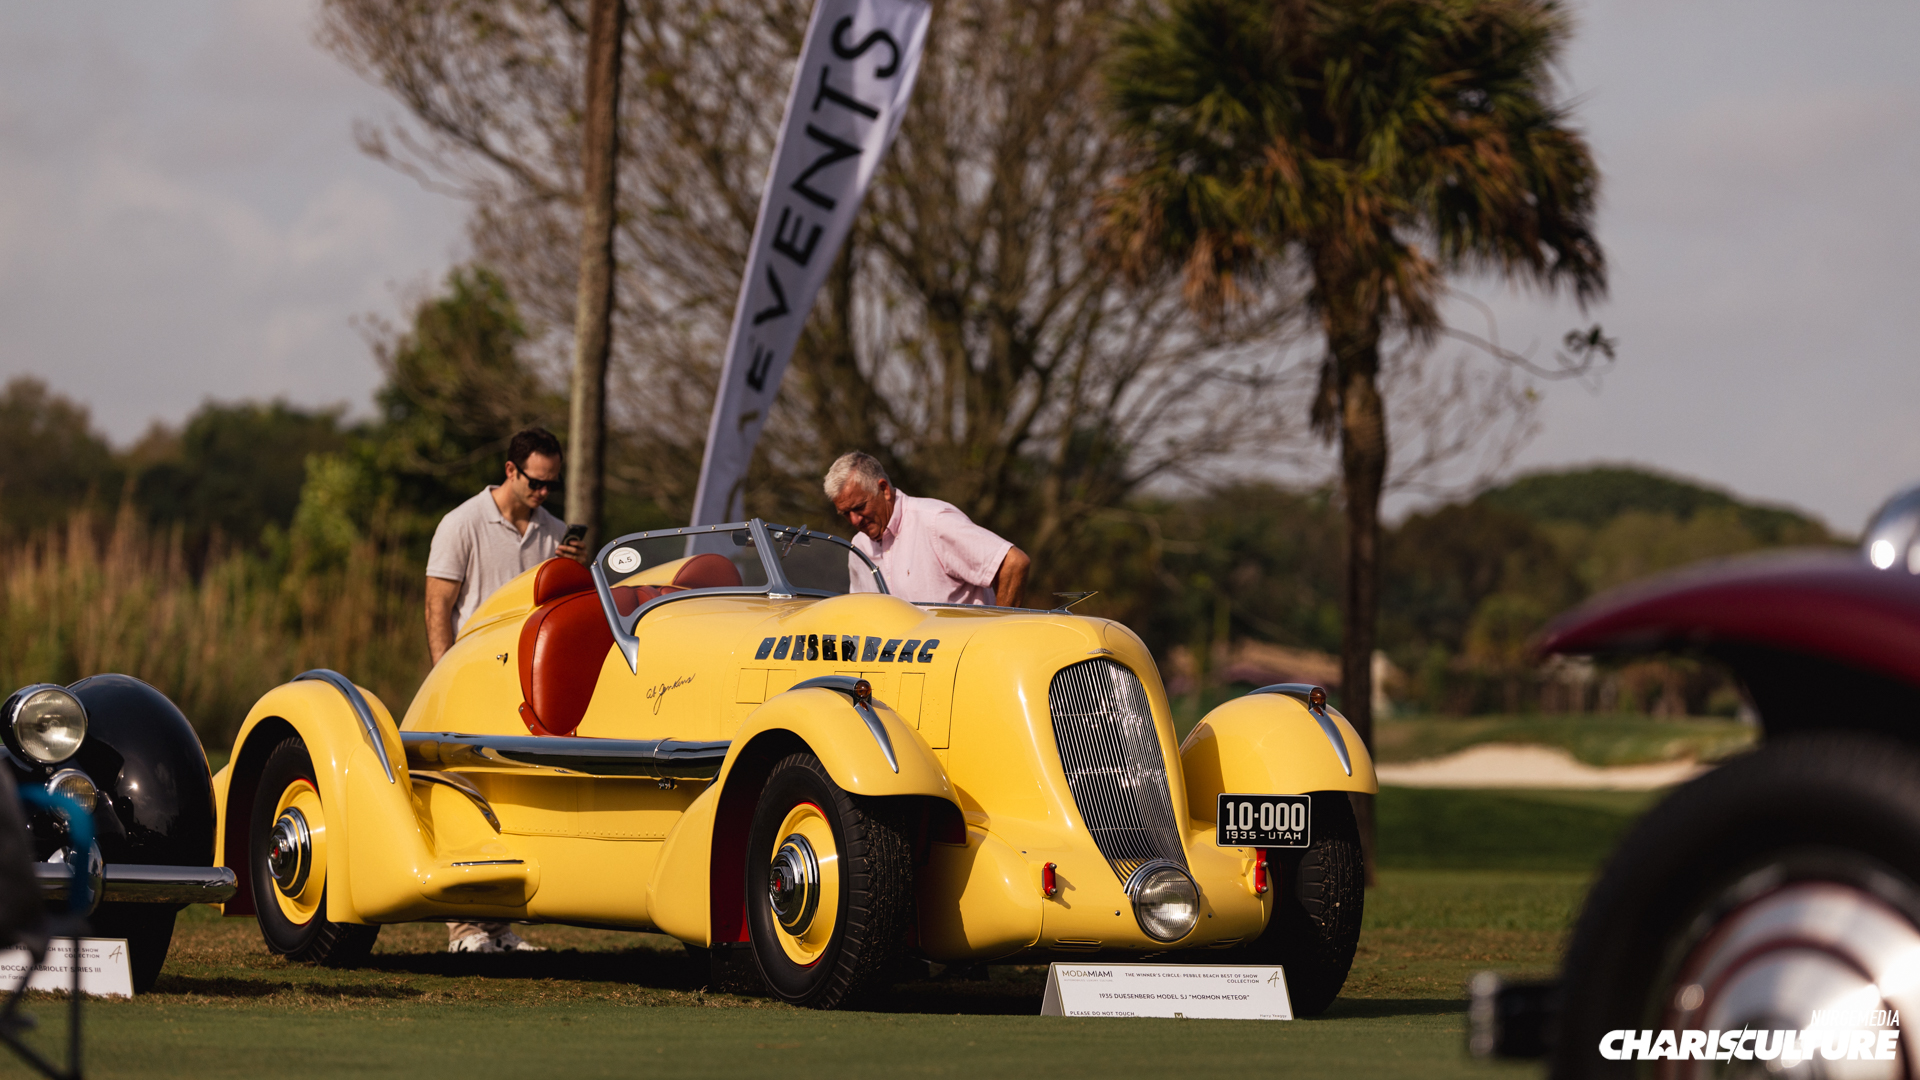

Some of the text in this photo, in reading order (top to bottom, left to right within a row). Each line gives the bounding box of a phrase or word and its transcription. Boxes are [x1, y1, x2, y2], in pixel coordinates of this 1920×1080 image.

[754, 634, 940, 663] DUESENBERG
[1226, 831, 1257, 839] 1935
[1268, 831, 1302, 840] UTAH
[1061, 970, 1113, 978] MODAMIAMI
